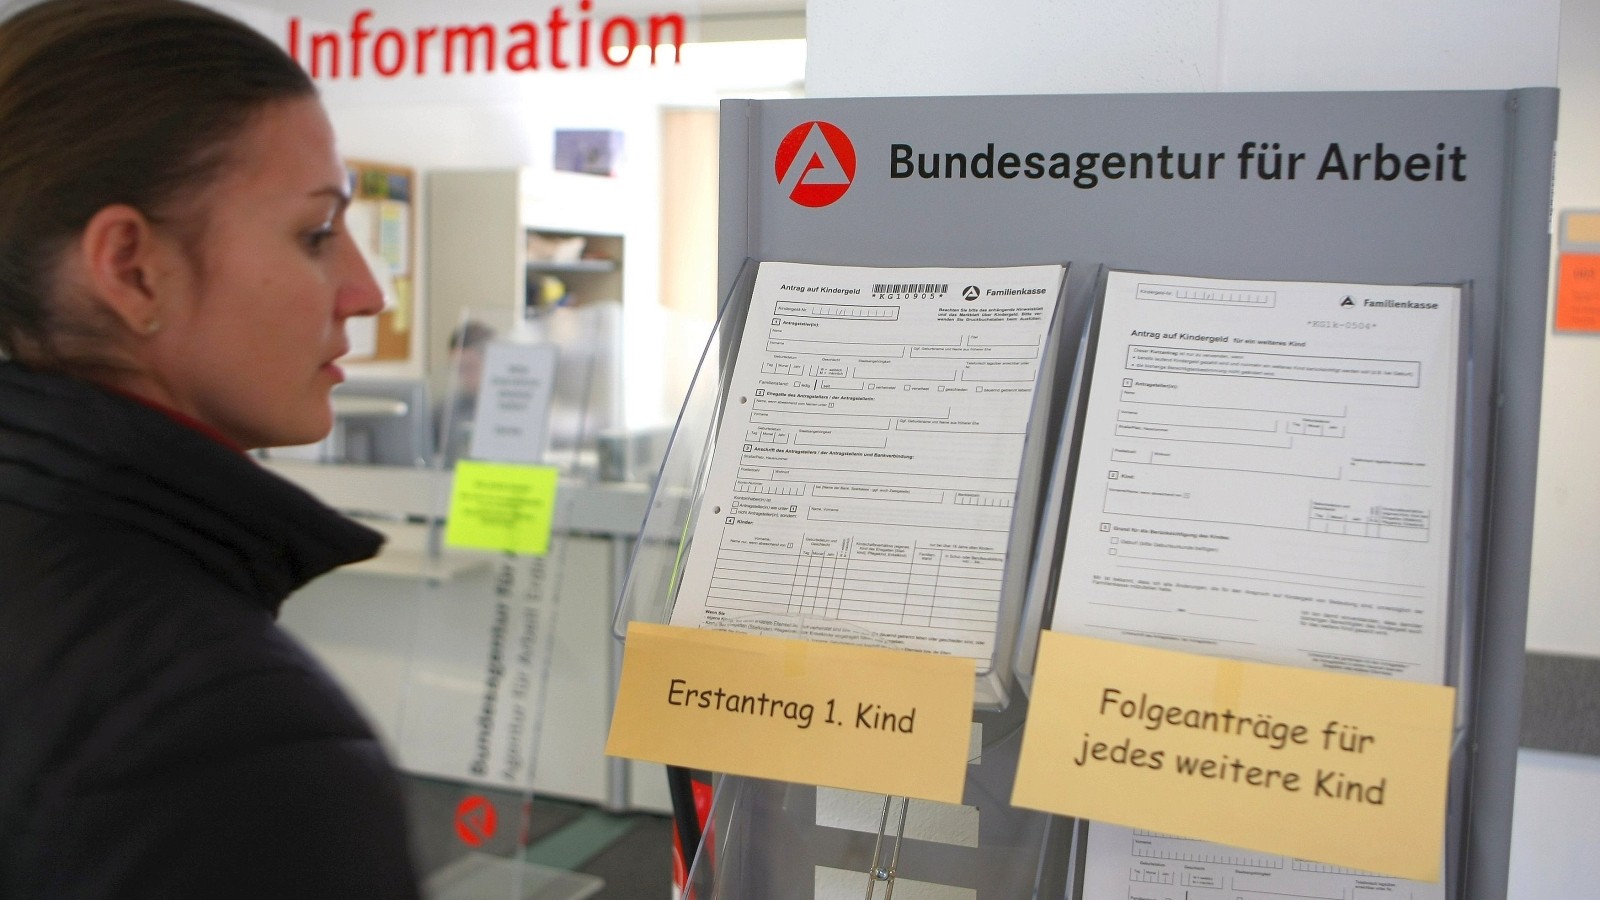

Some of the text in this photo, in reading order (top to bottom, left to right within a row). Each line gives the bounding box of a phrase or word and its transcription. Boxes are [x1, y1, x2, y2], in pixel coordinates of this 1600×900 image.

[288, 0, 686, 80] Information
[889, 141, 1468, 189] Bundesagentur für Arbeit
[780, 284, 804, 294] Antrag
[820, 286, 861, 296] Kindergeld
[986, 288, 1046, 296] Familienkasse
[1364, 299, 1439, 310] Familienkasse
[1131, 329, 1160, 340] Antrag
[1179, 333, 1229, 343] Kindergeld
[668, 678, 916, 734] Erstantrag 1. Kind
[1099, 688, 1375, 755] Folgeanträge für
[1073, 733, 1386, 806] jedes weitere Kind
